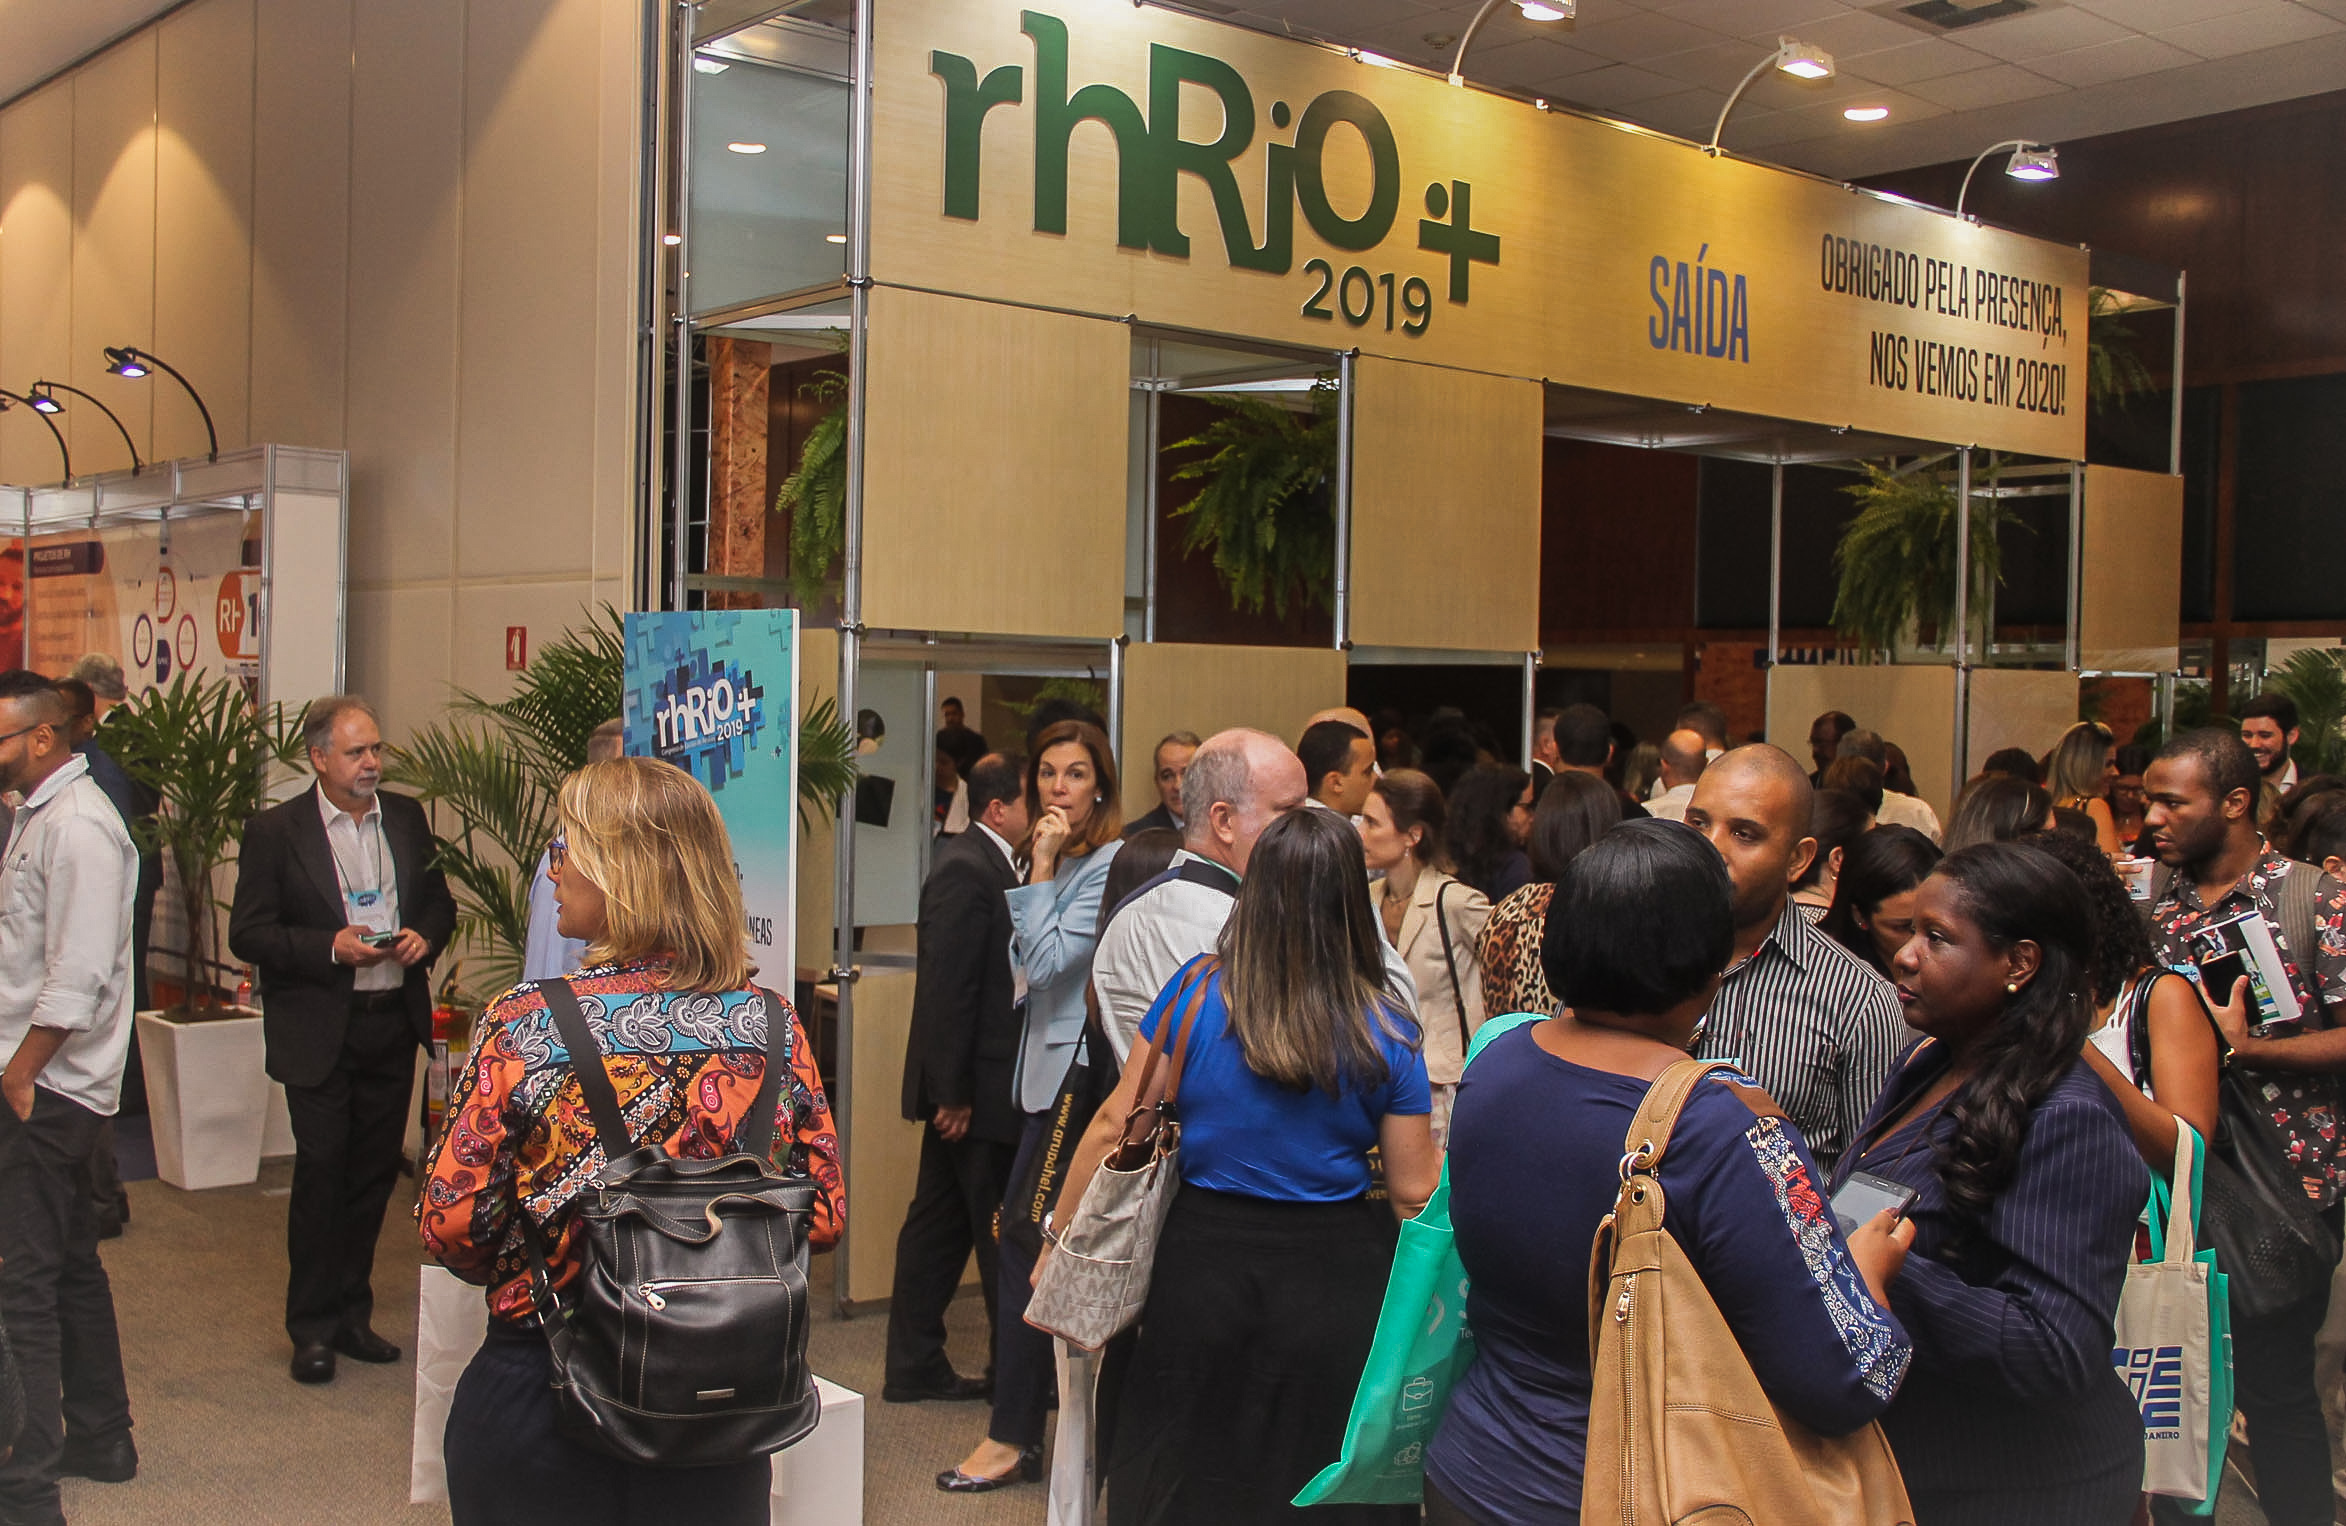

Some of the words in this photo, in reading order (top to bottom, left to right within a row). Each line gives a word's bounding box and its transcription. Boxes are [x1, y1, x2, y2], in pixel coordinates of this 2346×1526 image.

[1300, 258, 1433, 338] 2019
[1648, 243, 1750, 364] SAÍDA
[1821, 233, 1919, 309] OBRIGADO
[1925, 257, 1969, 319] PELA
[1975, 269, 2068, 350] PRESENÇA,
[1869, 331, 1908, 391] NOS
[1915, 339, 1978, 402] VEMOS
[1984, 352, 2011, 407] EM
[2015, 358, 2066, 416] 2020!
[716, 719, 744, 742] 2019
[747, 915, 773, 946] NEAS
